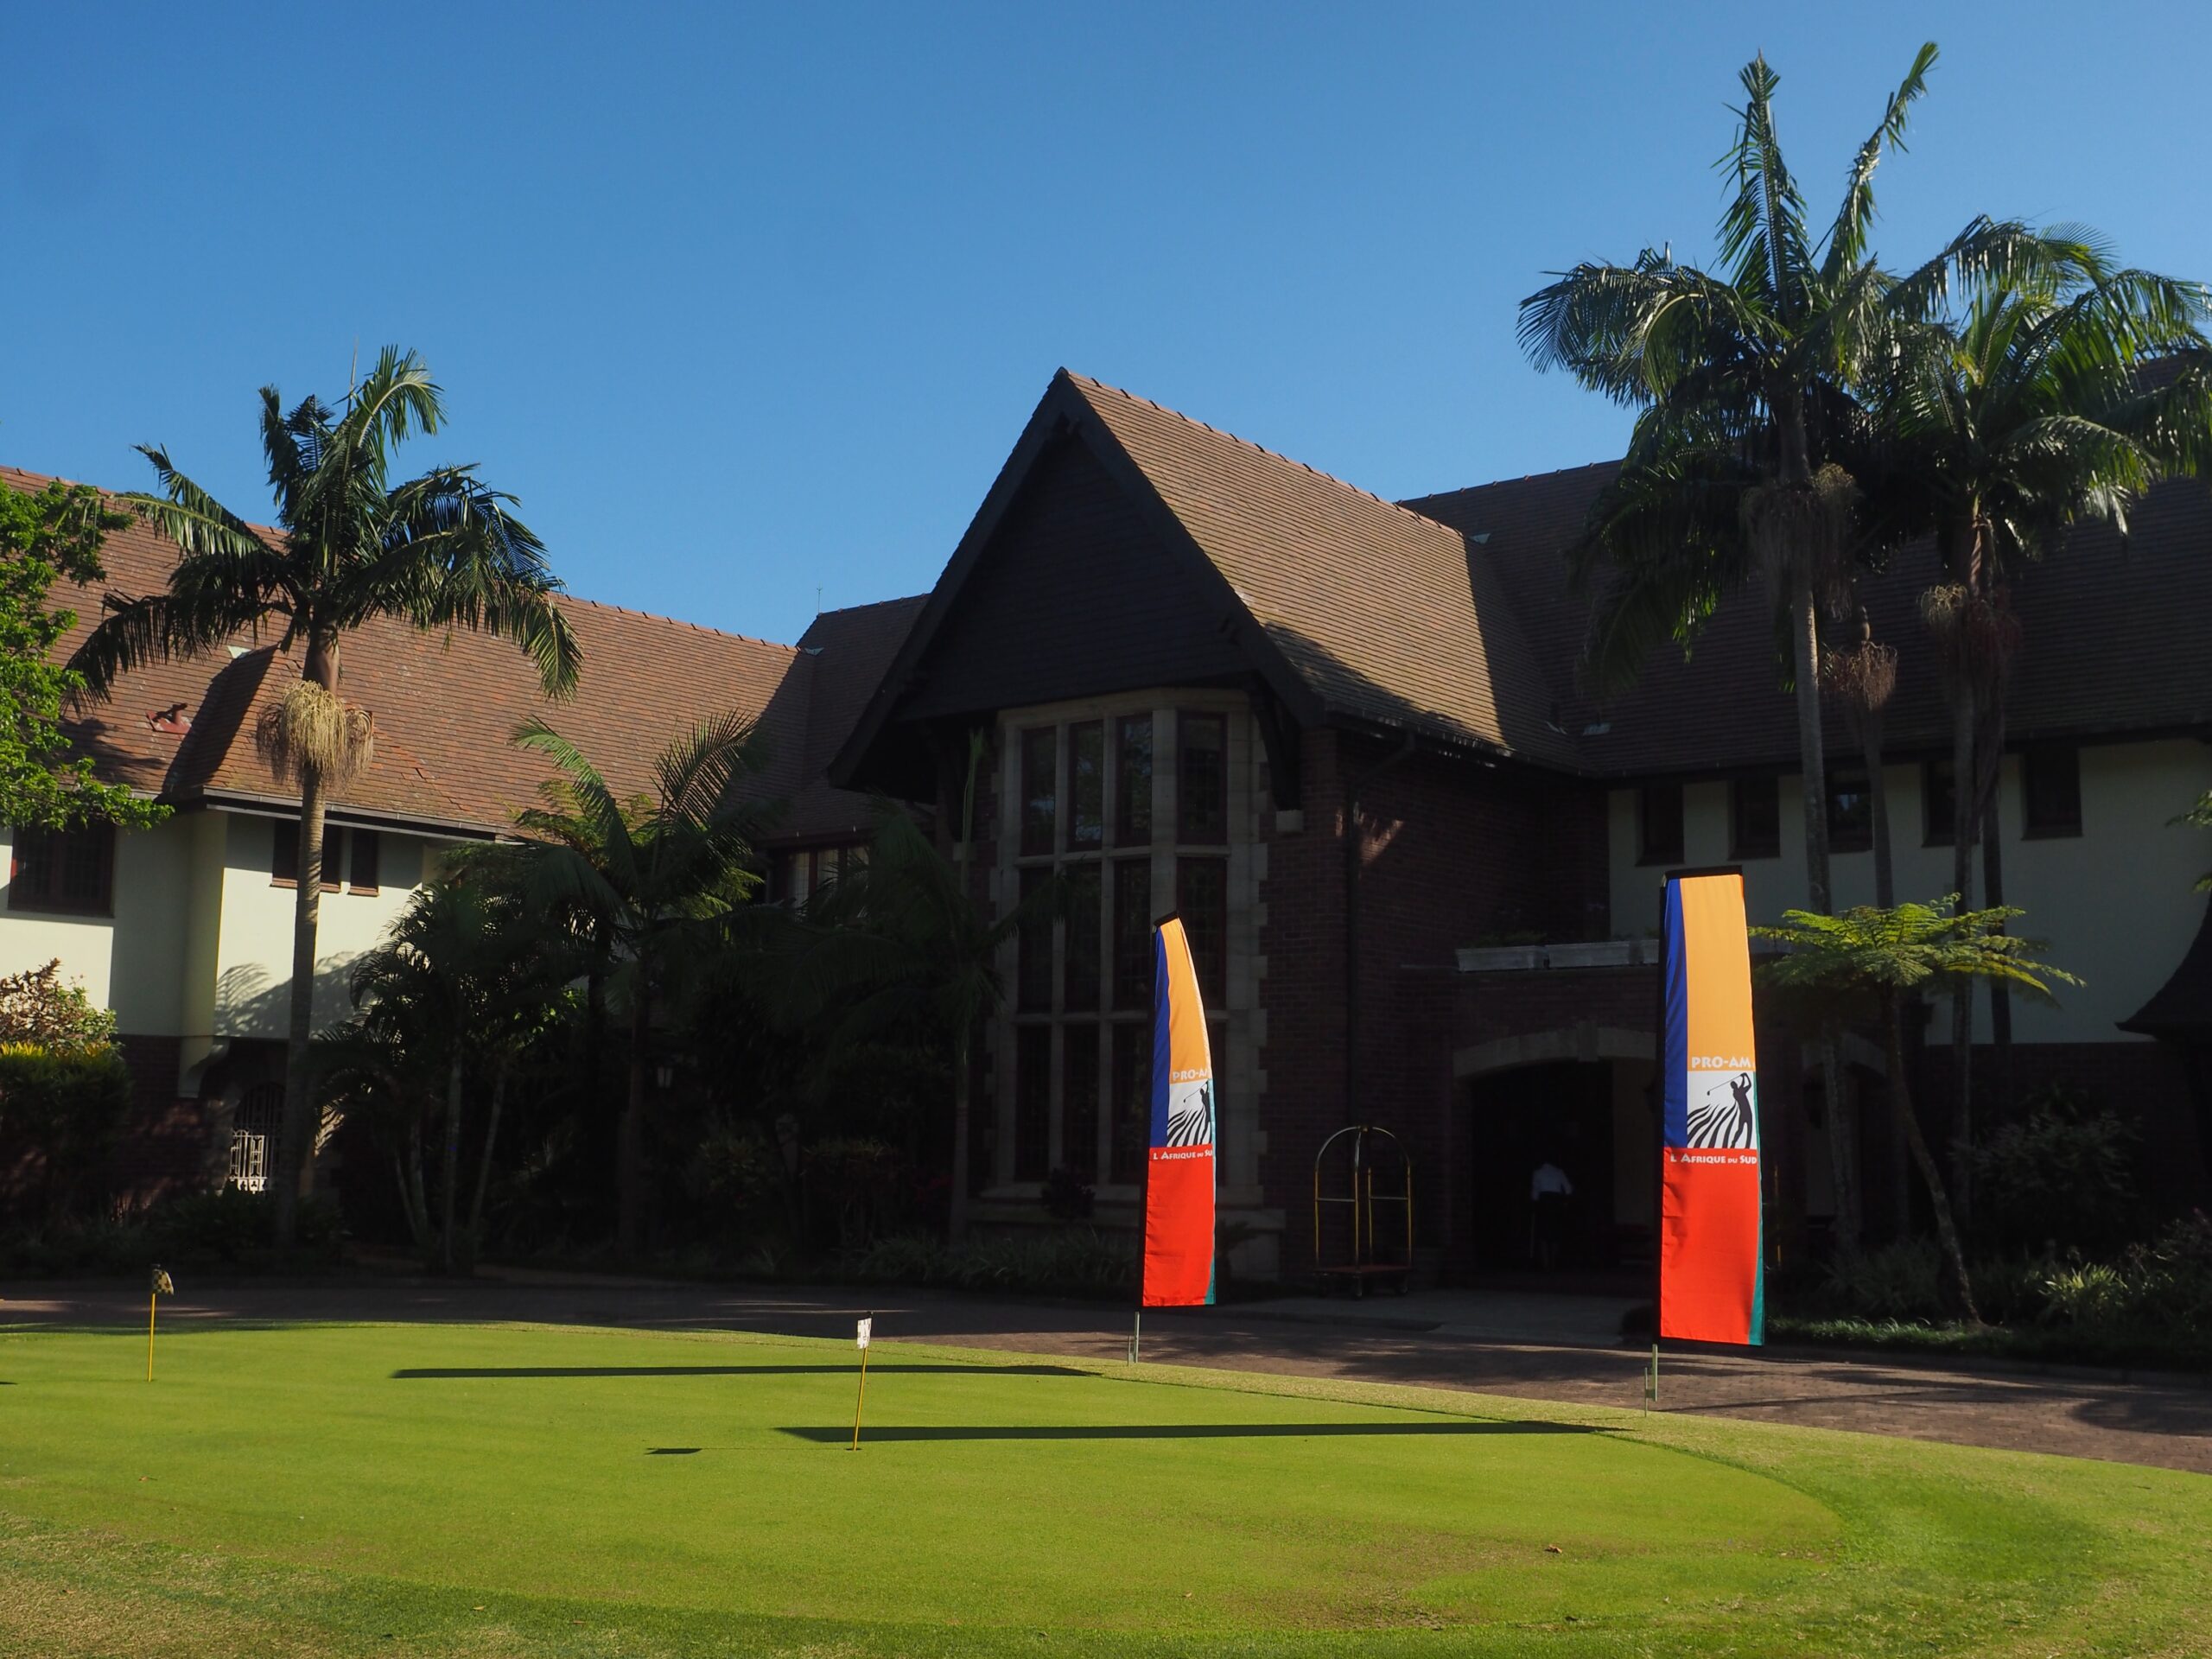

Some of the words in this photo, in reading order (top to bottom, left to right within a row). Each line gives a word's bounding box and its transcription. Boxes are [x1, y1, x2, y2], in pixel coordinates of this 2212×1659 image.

[1691, 1056, 1751, 1068] PRO-AM
[1160, 1151, 1196, 1160] AFRIQUE
[1681, 1153, 1726, 1164] AFRIQUE
[1739, 1154, 1758, 1164] SUD
